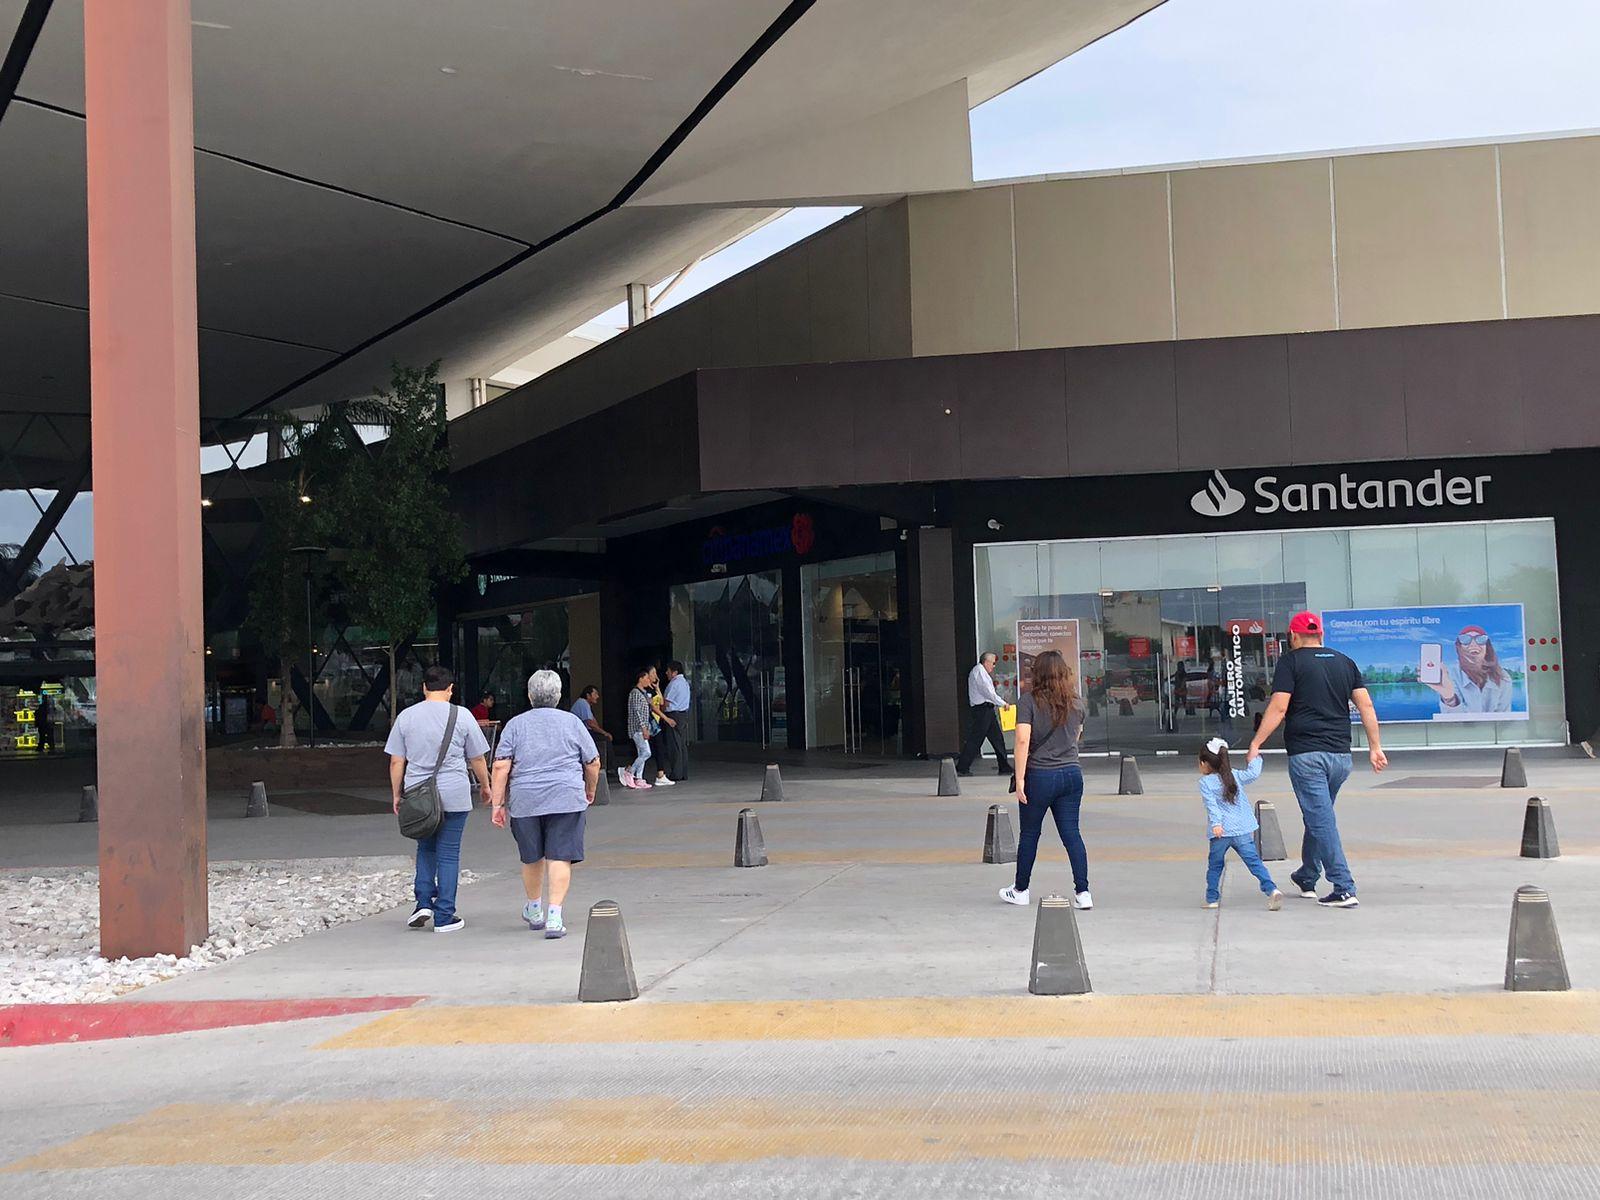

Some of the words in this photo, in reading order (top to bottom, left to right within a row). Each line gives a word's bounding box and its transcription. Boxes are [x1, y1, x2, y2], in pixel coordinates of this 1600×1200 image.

[1254, 469, 1492, 513] Santander
[1330, 618, 1363, 628] Conecta
[1365, 619, 1378, 627] con
[1380, 618, 1389, 626] tu
[1422, 615, 1441, 625] libre
[1227, 660, 1237, 718] CAJERO
[1232, 624, 1245, 718] AUTOMATICO
